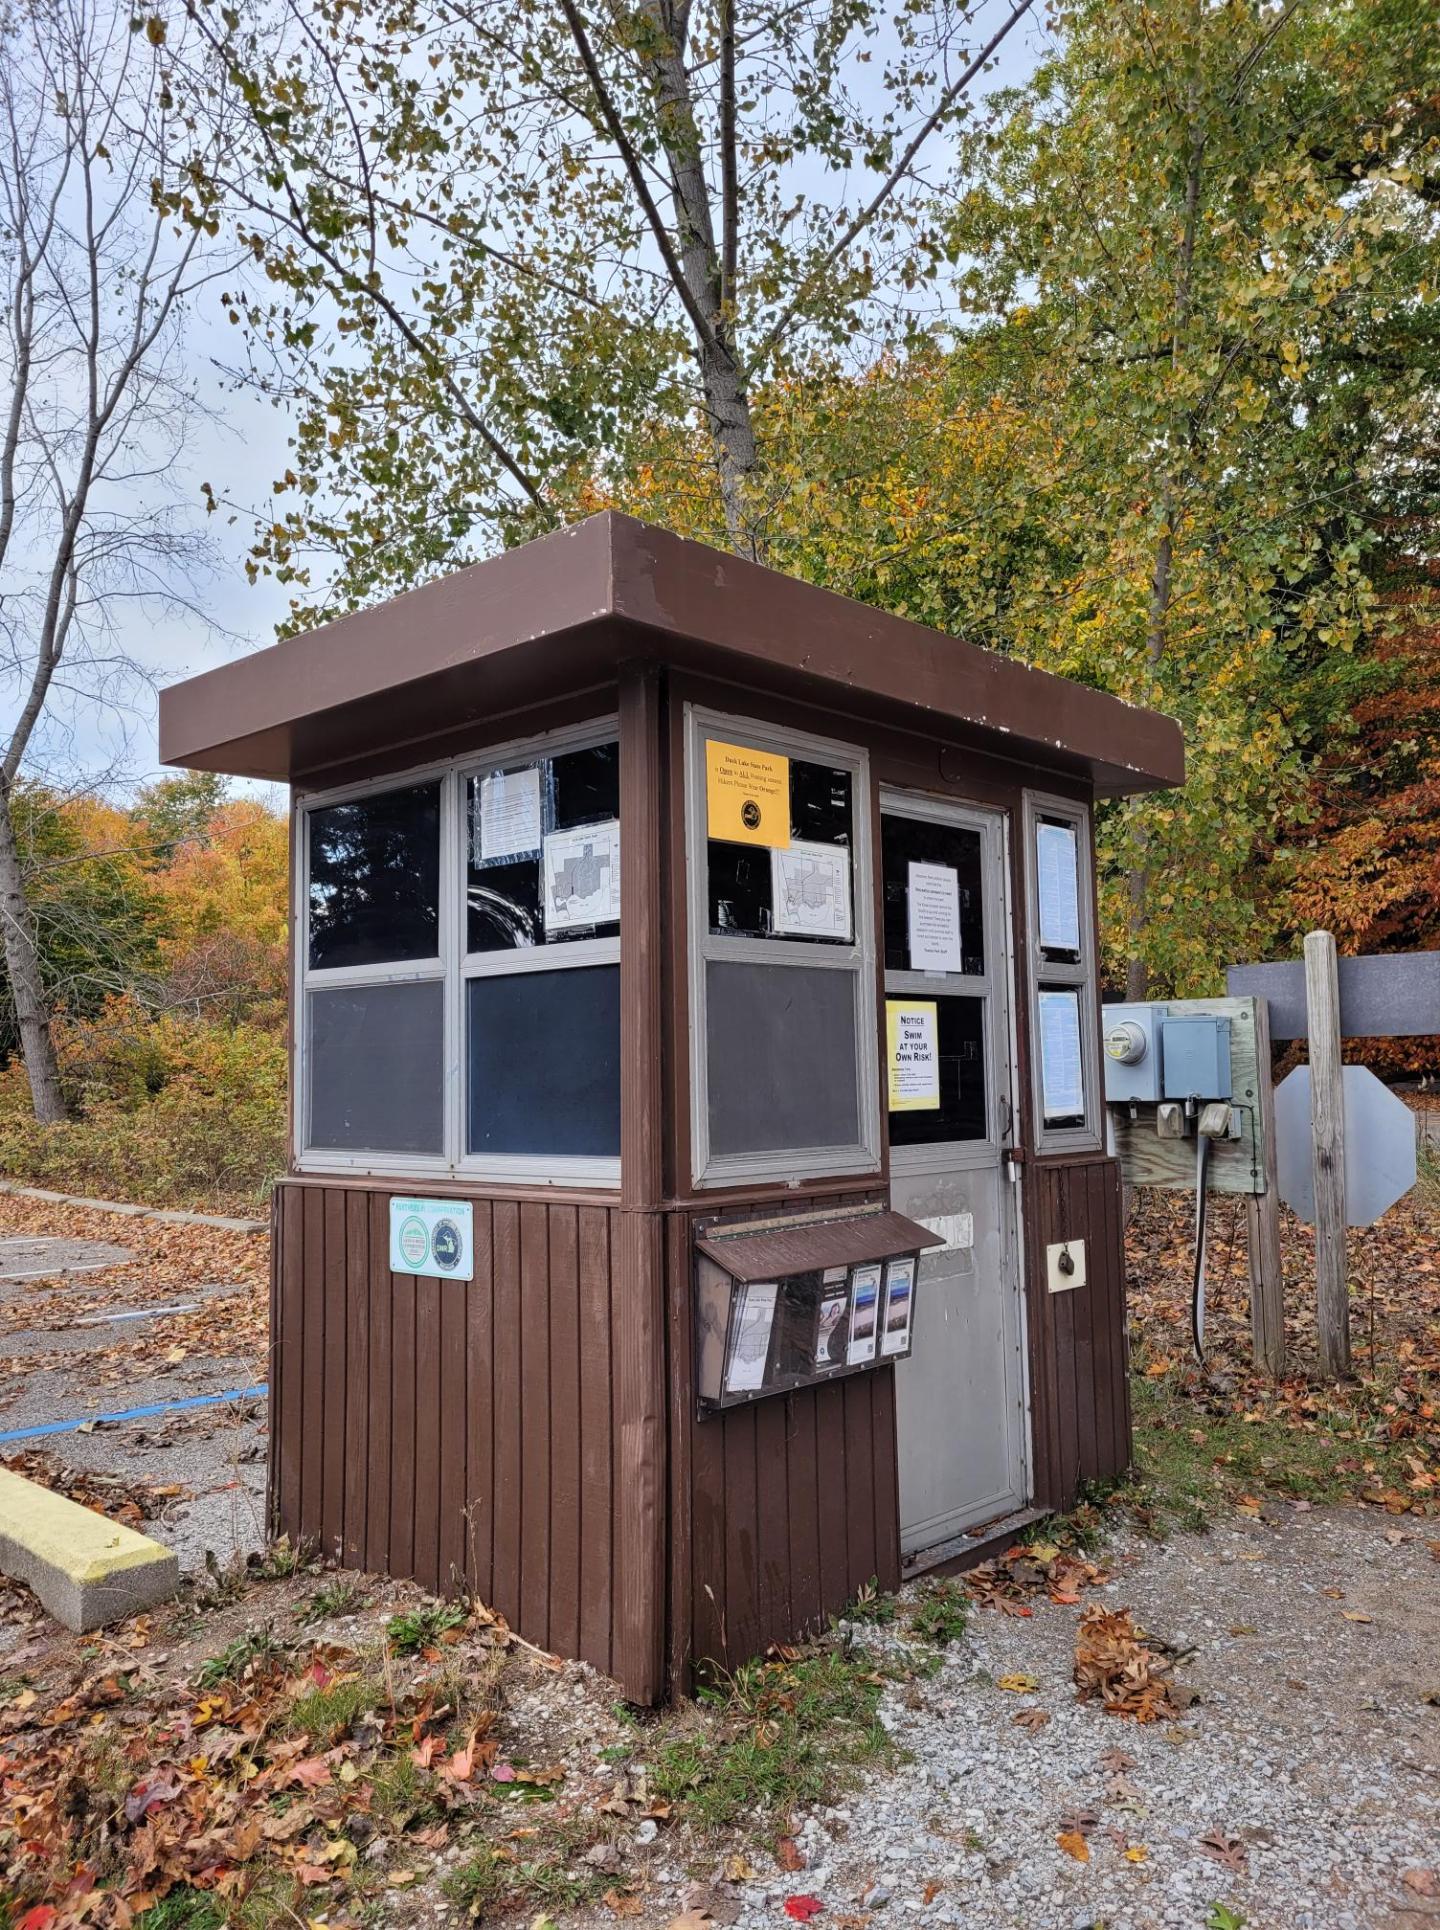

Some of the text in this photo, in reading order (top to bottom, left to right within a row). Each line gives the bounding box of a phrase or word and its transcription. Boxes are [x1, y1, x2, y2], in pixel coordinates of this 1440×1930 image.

[900, 1015, 925, 1025] NOTICE
[904, 1030, 923, 1040] SWIM
[899, 1042, 928, 1051] AT YOUR
[895, 1052, 932, 1062] OWN RISK!
